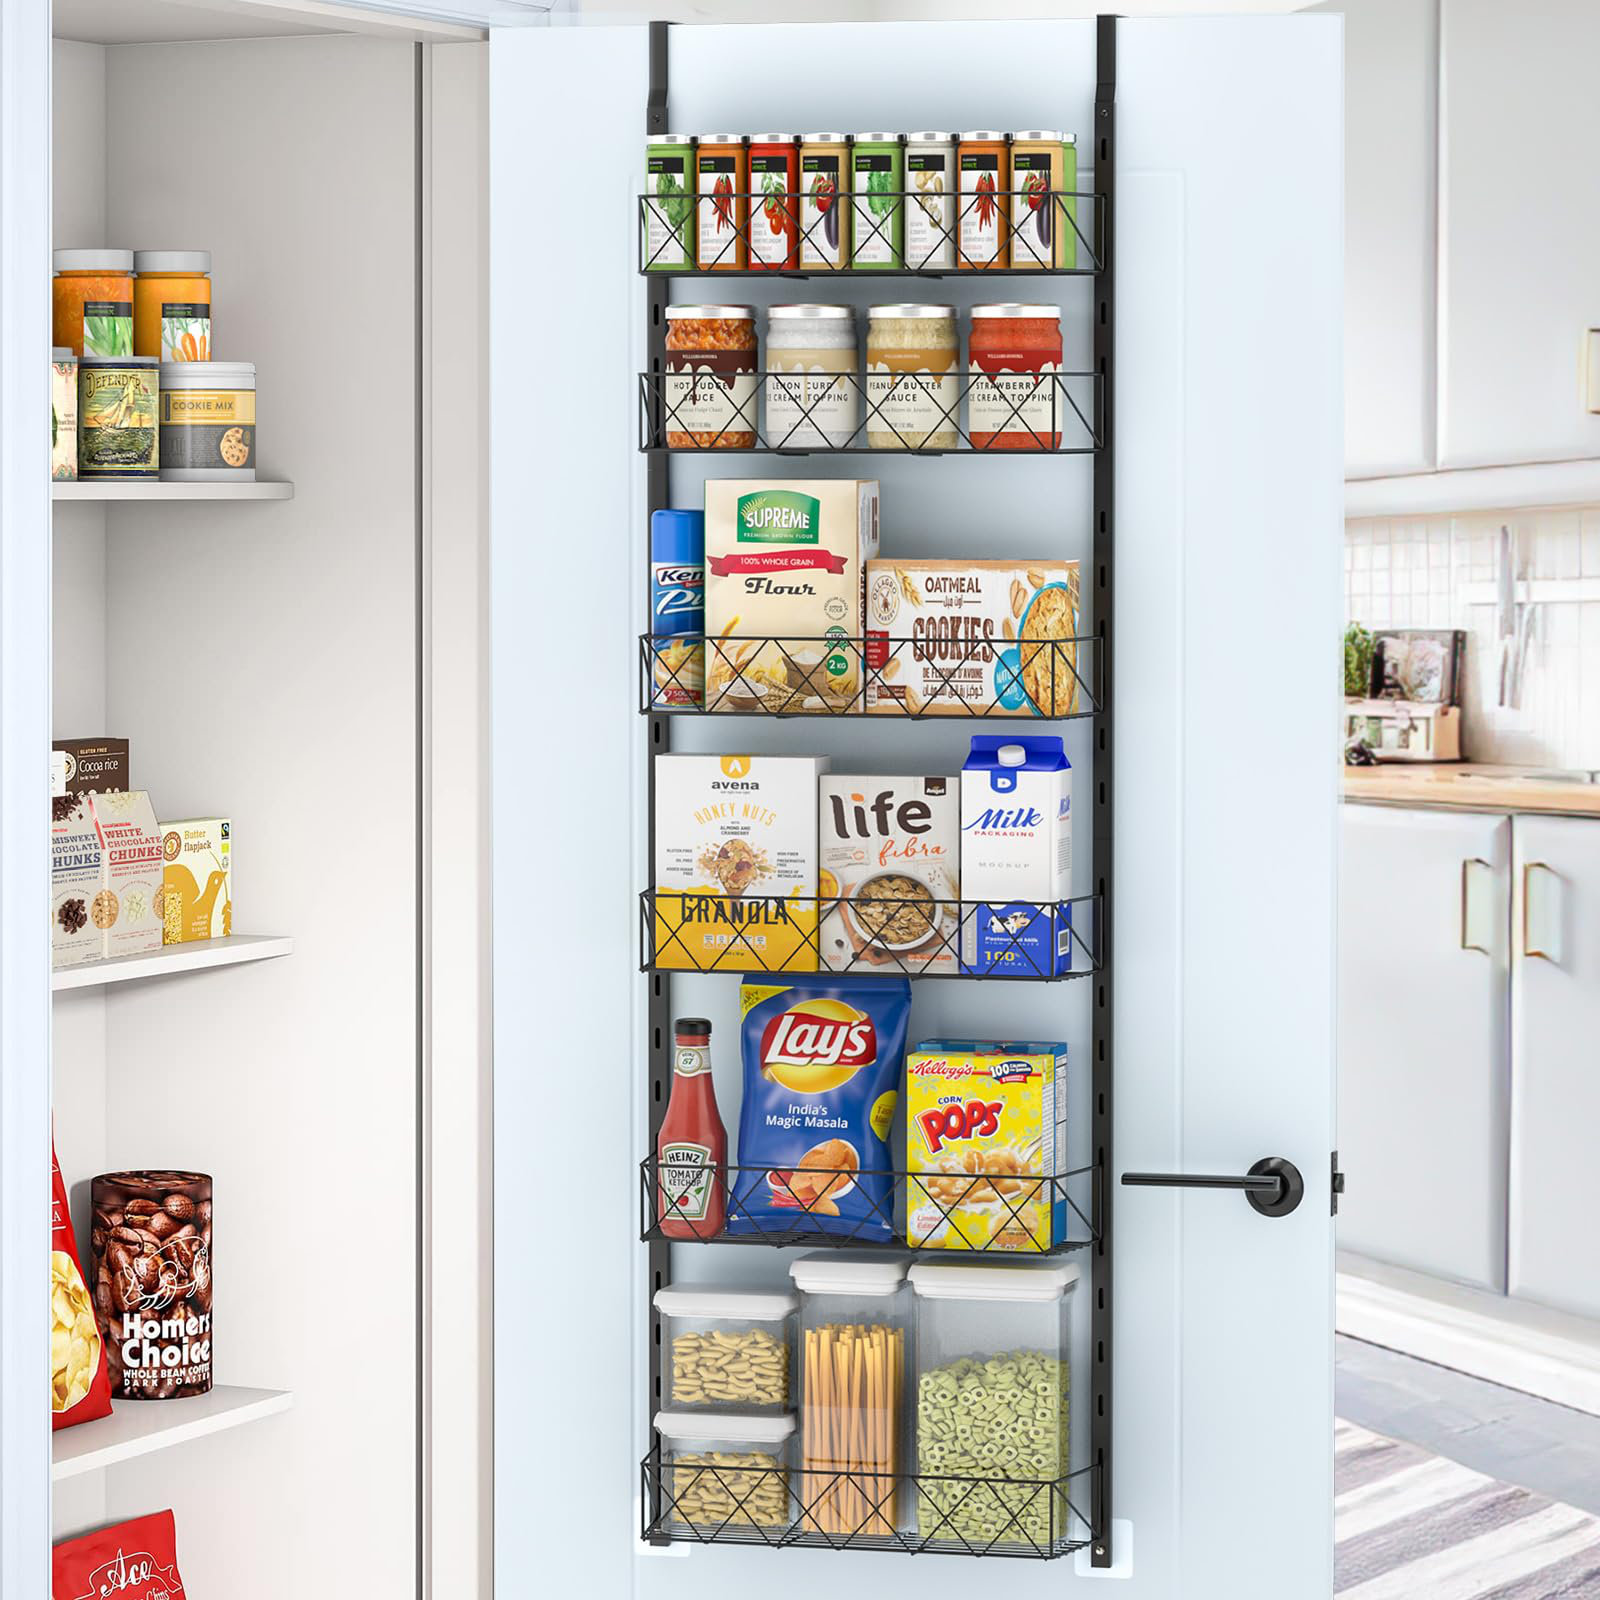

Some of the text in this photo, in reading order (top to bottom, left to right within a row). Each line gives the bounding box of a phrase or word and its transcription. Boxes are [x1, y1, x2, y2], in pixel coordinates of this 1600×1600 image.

[674, 382, 691, 390] HOT
[976, 382, 1038, 390] STRAWBERRY
[773, 394, 802, 402] CREAM
[807, 393, 848, 402] TOPPING
[885, 394, 917, 402] SAUCE
[976, 394, 1006, 402] CREAM
[173, 402, 233, 410] COOKIE MIX
[746, 507, 810, 529] SUPREME
[741, 557, 814, 566] 100% WHOLE GRAIN
[745, 577, 816, 595] Flour
[925, 577, 981, 593] OATMEAL
[913, 616, 994, 663] COOKIES
[829, 660, 836, 669] 2
[80, 758, 119, 772] Cocoa rice
[712, 781, 760, 790] avena
[694, 802, 776, 826] HONEY NUTS
[829, 790, 932, 838] life
[962, 808, 1044, 830] Milk
[104, 828, 143, 839] WHITE
[184, 830, 206, 839] Butter
[107, 836, 162, 848] CHOCOLATE
[184, 841, 212, 853] flapjack
[109, 846, 162, 861] CHUNKS
[879, 837, 948, 866] fibra
[53, 852, 101, 867] HUNKS
[681, 893, 788, 925] GRANOLA
[764, 1014, 871, 1065] Lay's
[914, 1060, 973, 1080] Kellogg's
[990, 1064, 1009, 1078] 100
[938, 1096, 962, 1105] CORN
[788, 1104, 828, 1116] India's
[766, 1115, 848, 1129] Magic Masala
[915, 1099, 1004, 1153] POPS
[668, 1152, 700, 1164] HEINZ
[668, 1169, 702, 1179] TOMATO
[669, 1178, 702, 1187] KETCHUP
[123, 1313, 210, 1339] Homers
[122, 1336, 210, 1368] Choice
[123, 1369, 158, 1379] WHOLE
[161, 1368, 186, 1378] BEAN
[124, 1379, 158, 1387] DARK
[100, 1548, 153, 1597] Ace
